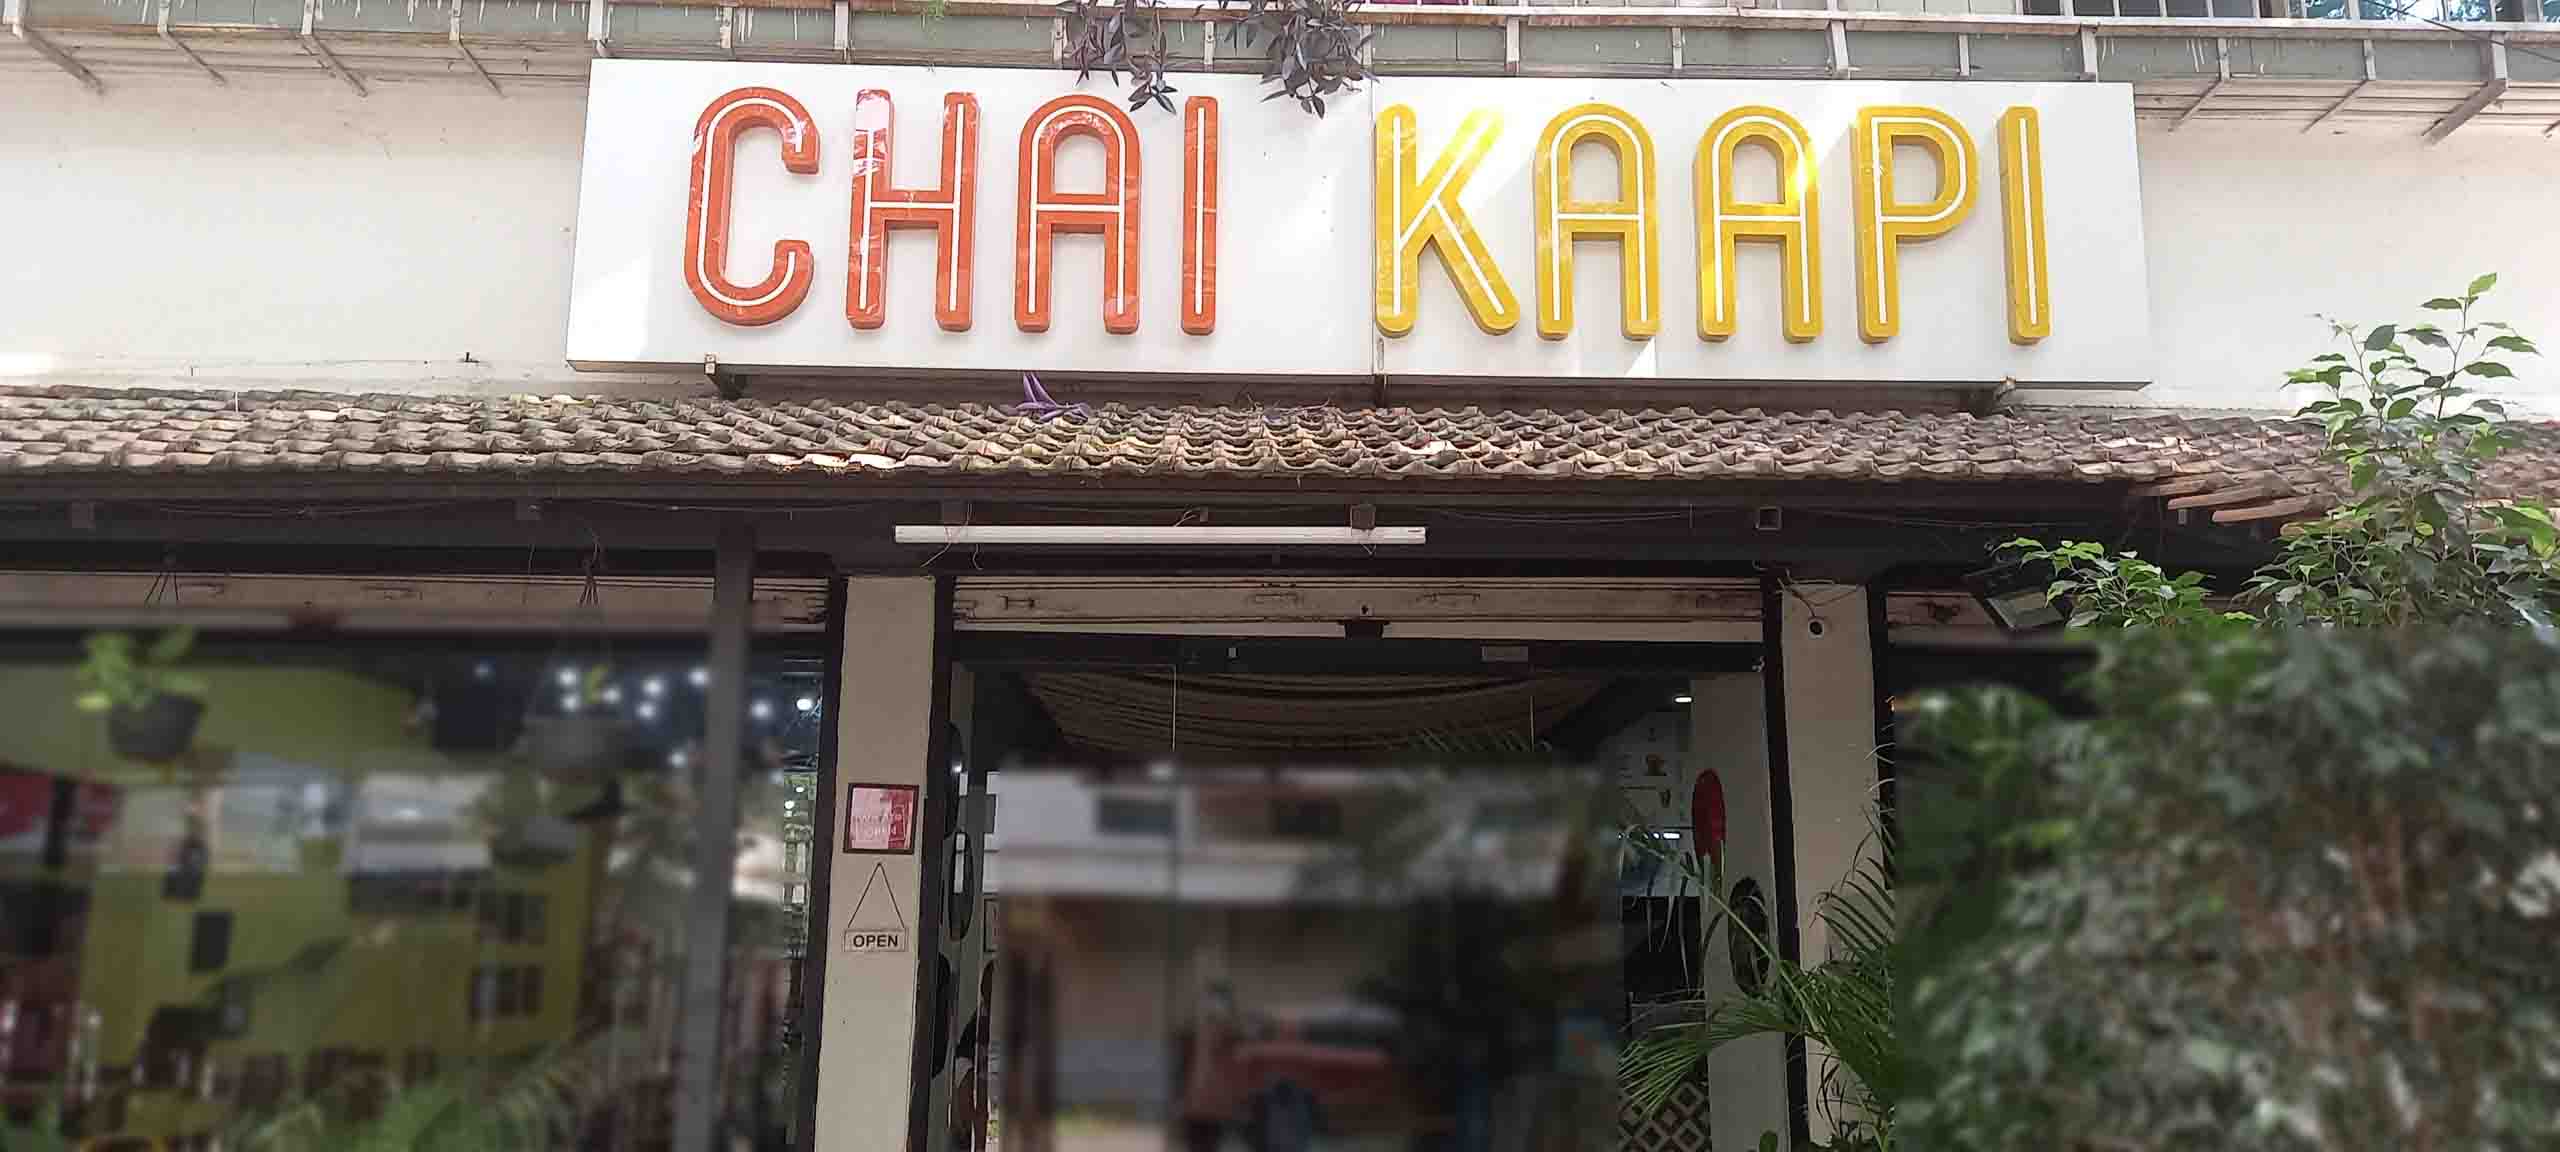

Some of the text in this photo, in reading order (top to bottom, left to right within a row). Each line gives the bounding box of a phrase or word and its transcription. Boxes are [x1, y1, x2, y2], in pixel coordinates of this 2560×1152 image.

[684, 86, 2052, 345] CHAI KAAPI
[852, 934, 899, 948] OPEN
